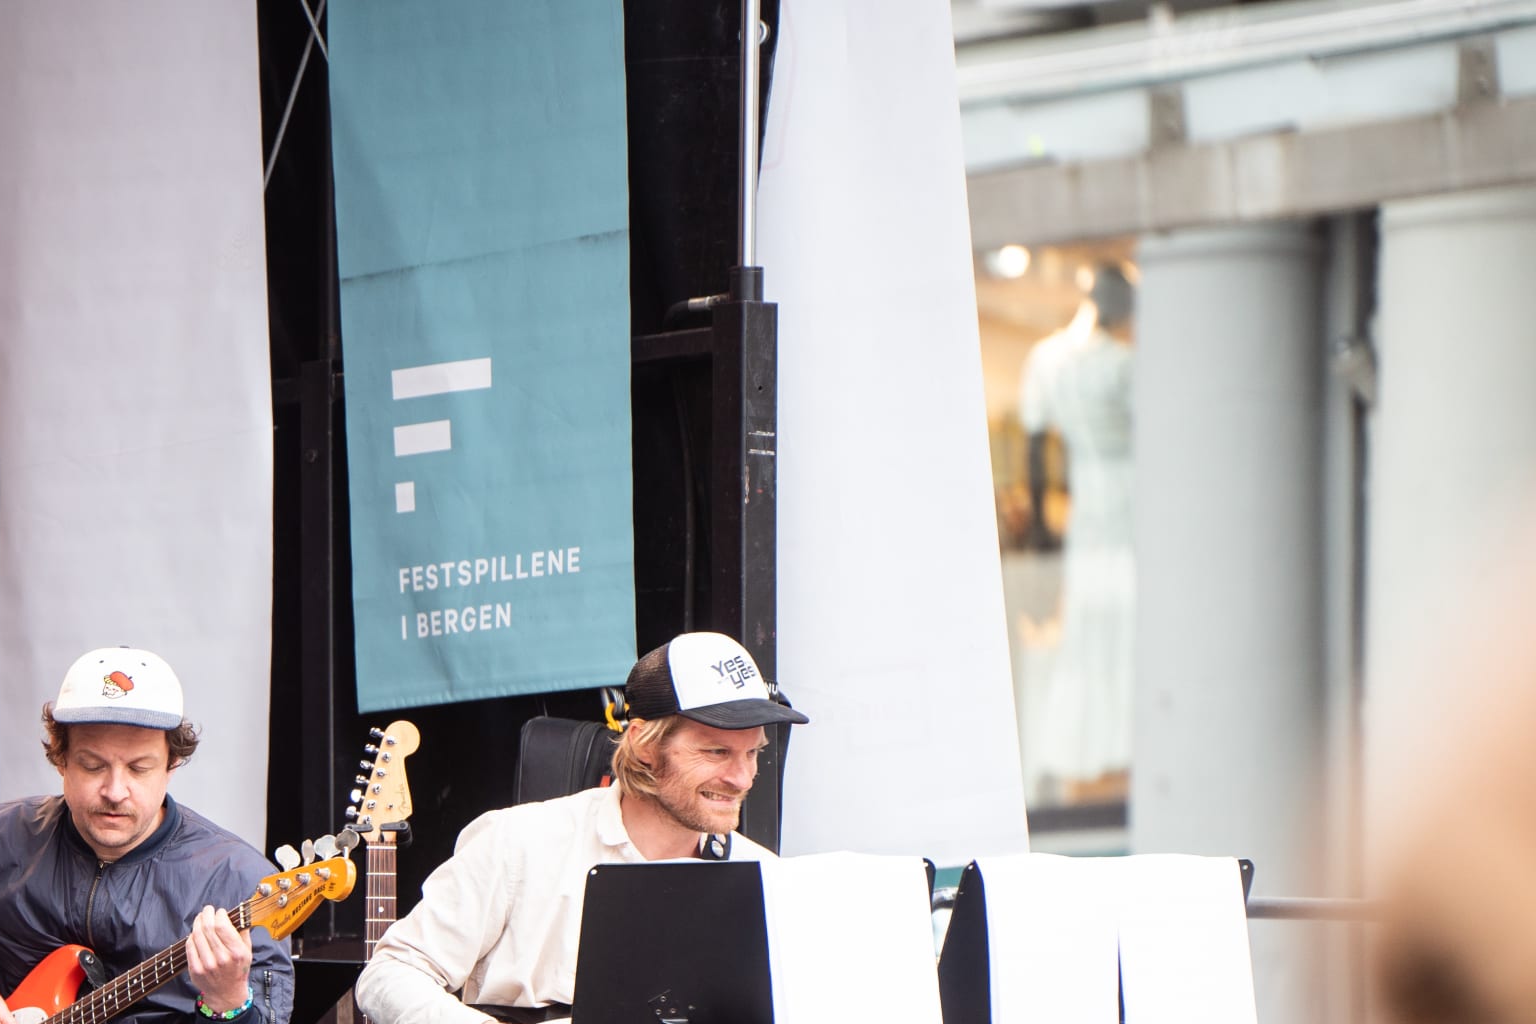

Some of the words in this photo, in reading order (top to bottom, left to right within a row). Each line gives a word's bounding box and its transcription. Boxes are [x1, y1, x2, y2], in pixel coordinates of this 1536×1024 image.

[399, 546, 581, 593] FESTSPILLENE
[401, 615, 408, 640] I
[417, 602, 512, 638] BERGEN
[710, 655, 745, 677] Yes
